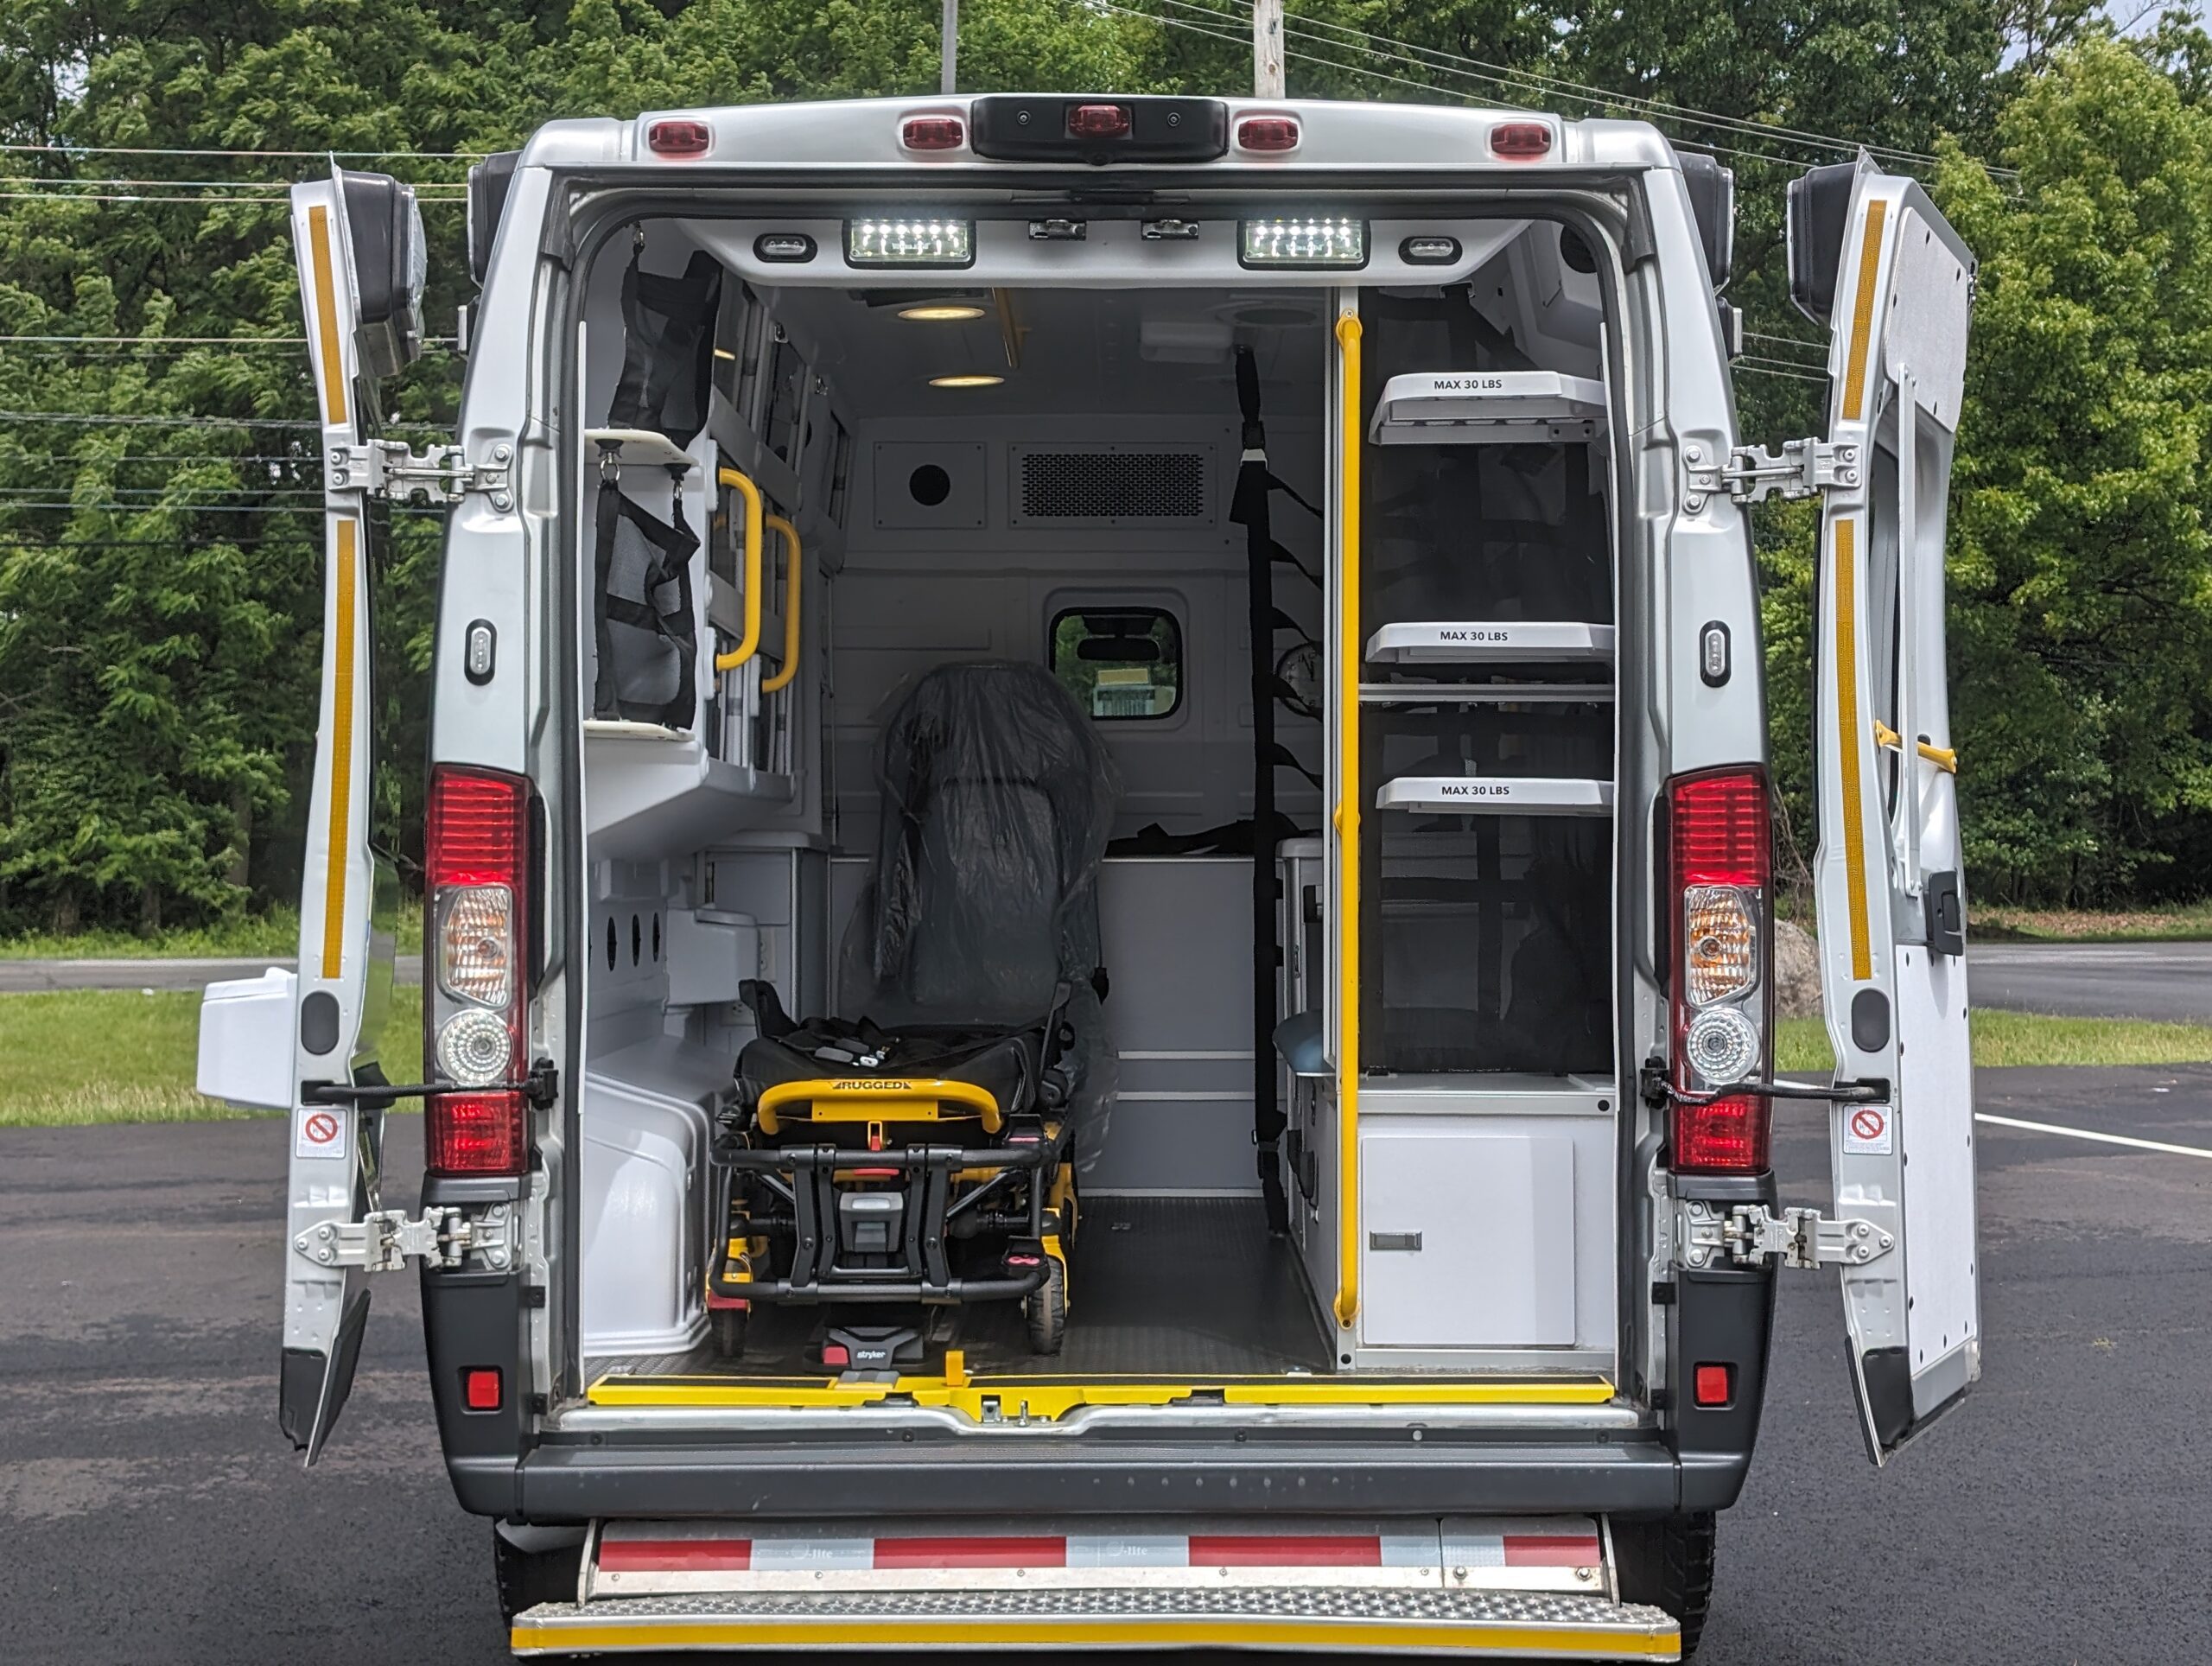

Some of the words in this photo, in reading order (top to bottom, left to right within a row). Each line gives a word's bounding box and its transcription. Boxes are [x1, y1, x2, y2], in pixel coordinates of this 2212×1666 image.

[1433, 380, 1461, 390] MAX
[1464, 380, 1479, 389] 30
[1482, 379, 1503, 389] LBS
[1440, 631, 1468, 640] MAX
[1470, 632, 1484, 641] 30
[1488, 632, 1509, 641] LBS
[1441, 786, 1469, 796] MAX
[1471, 785, 1486, 795] 30
[1490, 785, 1510, 795] LBS
[842, 1081, 903, 1090] RUGGED
[857, 1351, 886, 1359] stryker
